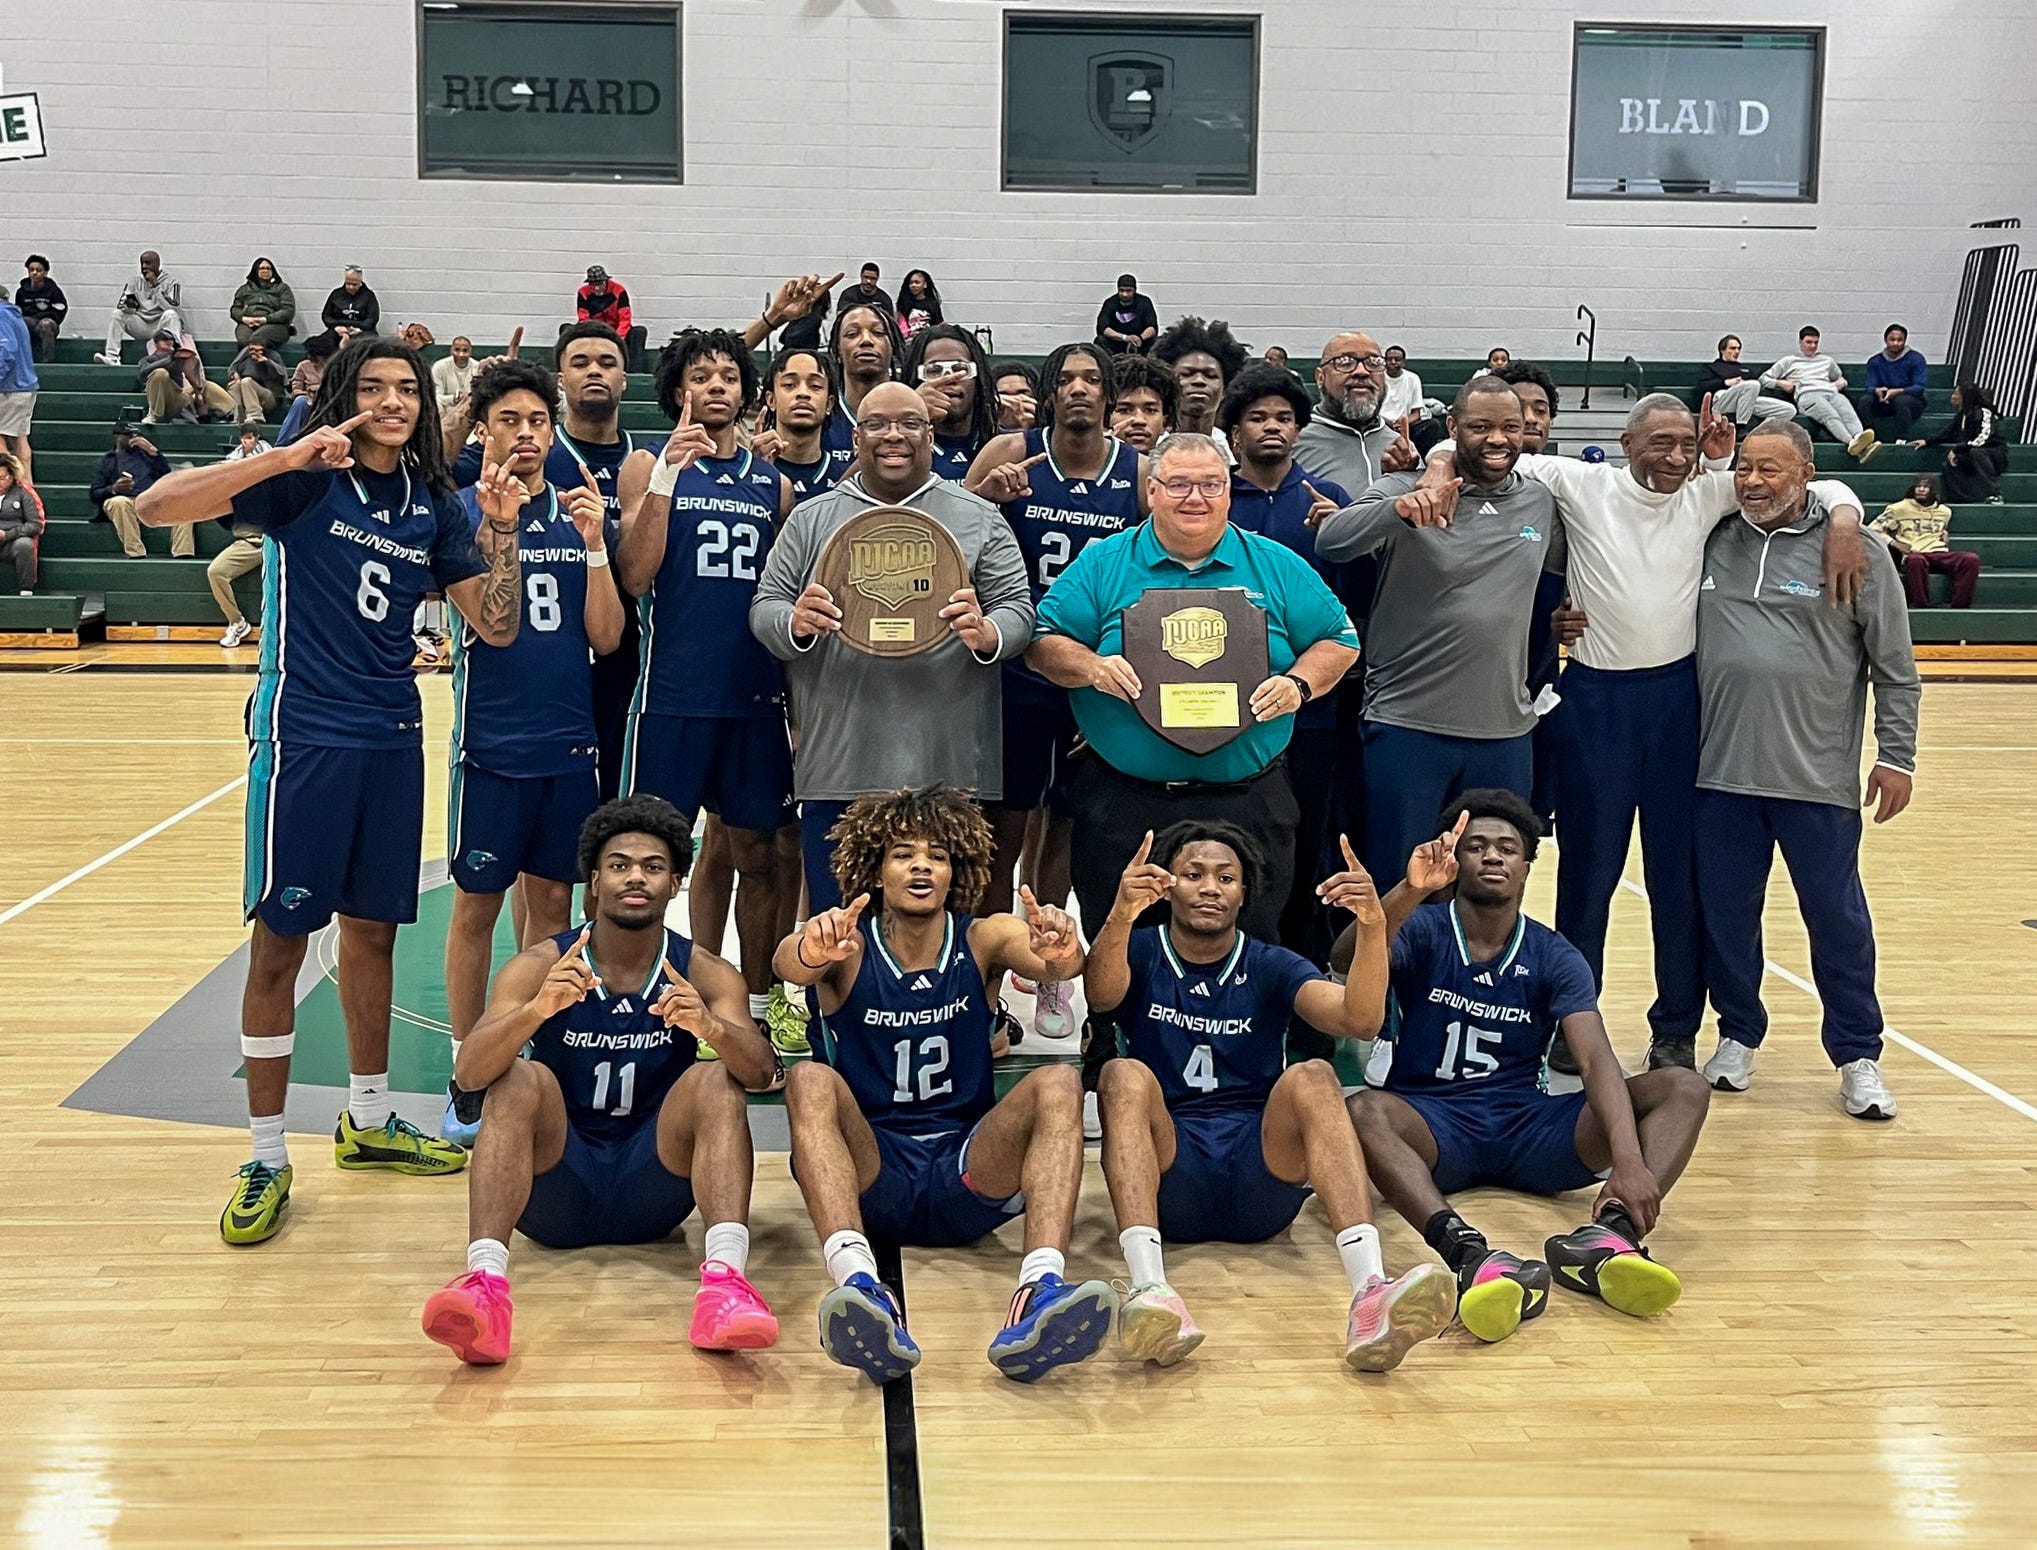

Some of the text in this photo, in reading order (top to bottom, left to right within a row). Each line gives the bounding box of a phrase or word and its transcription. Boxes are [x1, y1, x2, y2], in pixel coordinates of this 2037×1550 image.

[442, 74, 661, 116] RICHARD
[0, 107, 29, 143] E
[1618, 98, 1770, 136] BLAND
[676, 497, 772, 521] BRUNSWICK
[1025, 505, 1126, 529] BRUNSWICK
[330, 520, 432, 566] BRUNSWICK
[519, 548, 586, 563] NSWICK
[697, 520, 760, 580] 22
[851, 540, 934, 579] NJCAA
[357, 560, 391, 622] 6
[526, 573, 562, 631] 8
[913, 578, 930, 592] 10
[1164, 618, 1226, 648] NJCAA
[1148, 1003, 1252, 1035] BRUNSWICK
[1428, 988, 1532, 1023] BRUNSWICK
[562, 1029, 673, 1050] BRUNSWICK
[1435, 1021, 1503, 1081] 15
[893, 1035, 953, 1102] 12
[1182, 1044, 1219, 1094] 4
[592, 1061, 636, 1117] 11
